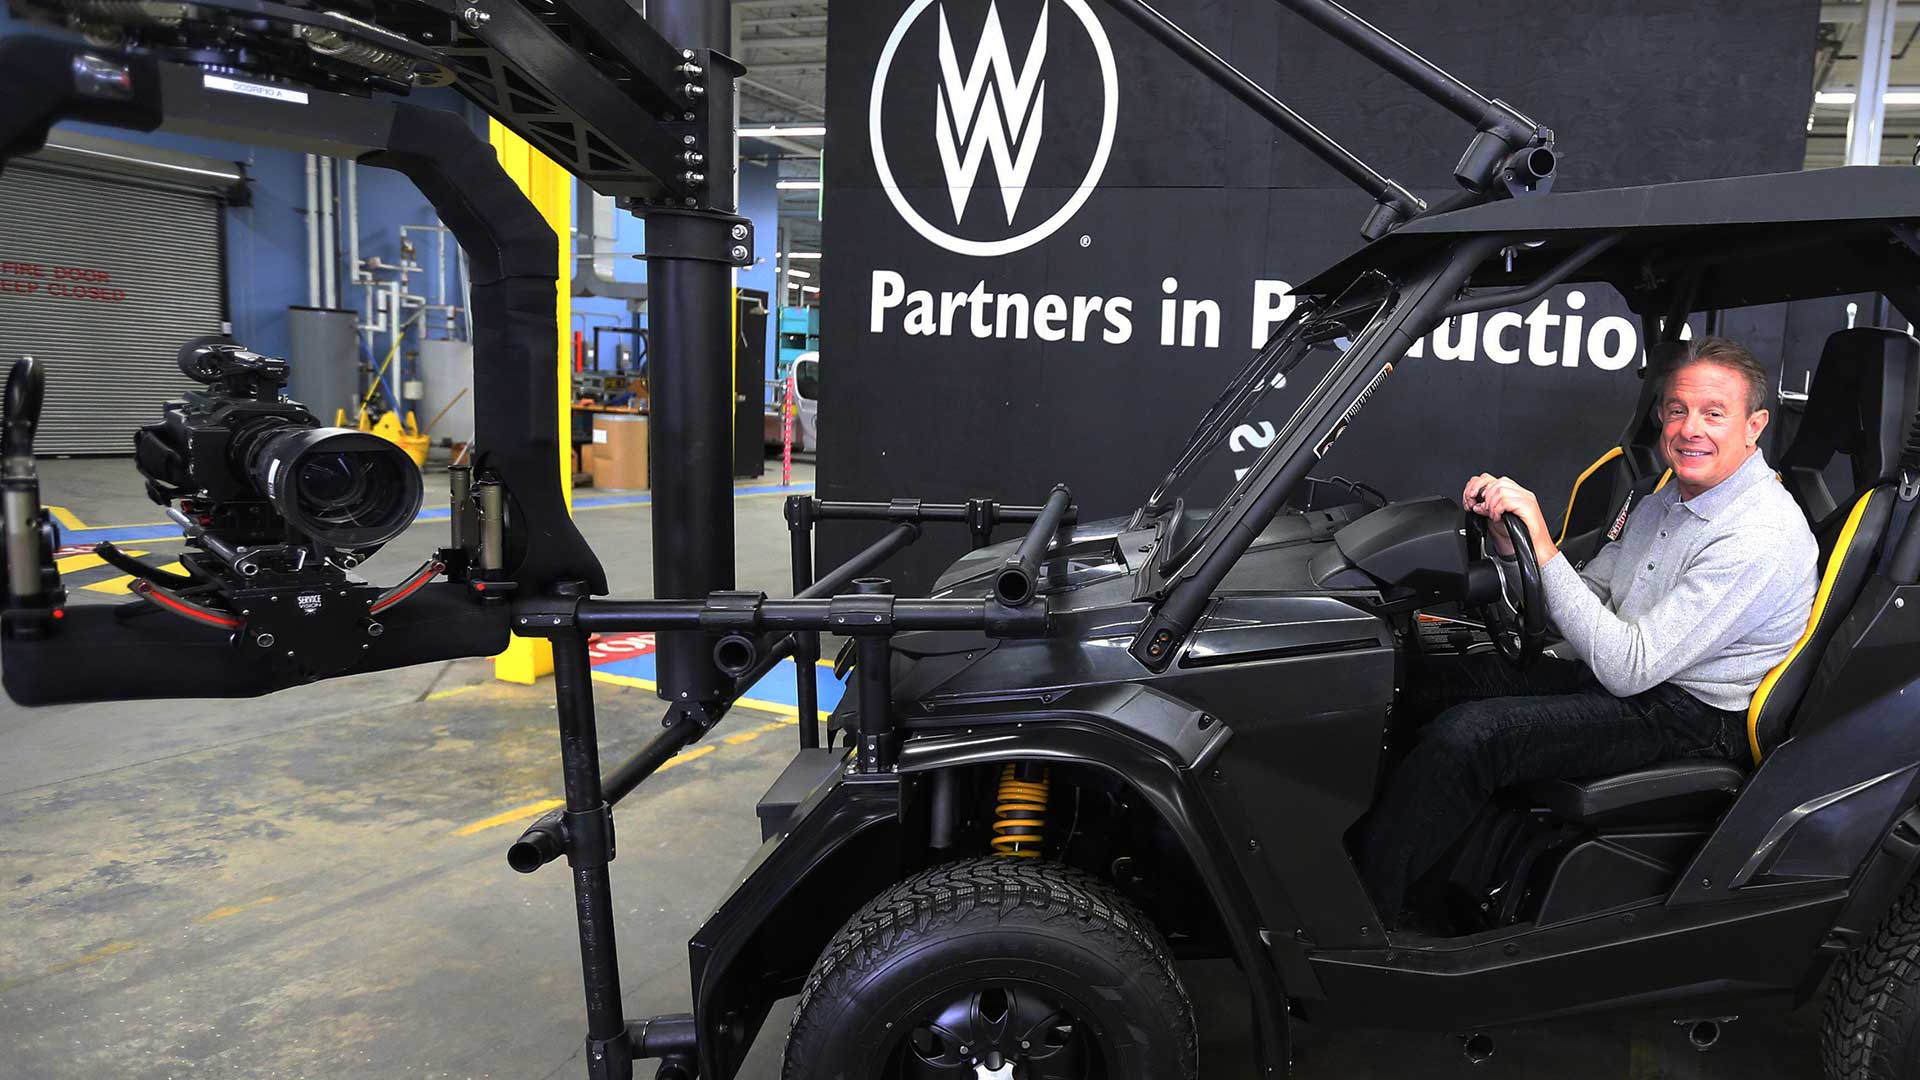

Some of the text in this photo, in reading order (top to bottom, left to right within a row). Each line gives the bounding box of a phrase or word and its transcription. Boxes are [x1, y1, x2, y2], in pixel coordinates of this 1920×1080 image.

[1, 262, 110, 282] FIRE DOOR
[0, 280, 126, 301] EEP CLOSED
[870, 270, 1693, 371] Partners in Puctio
